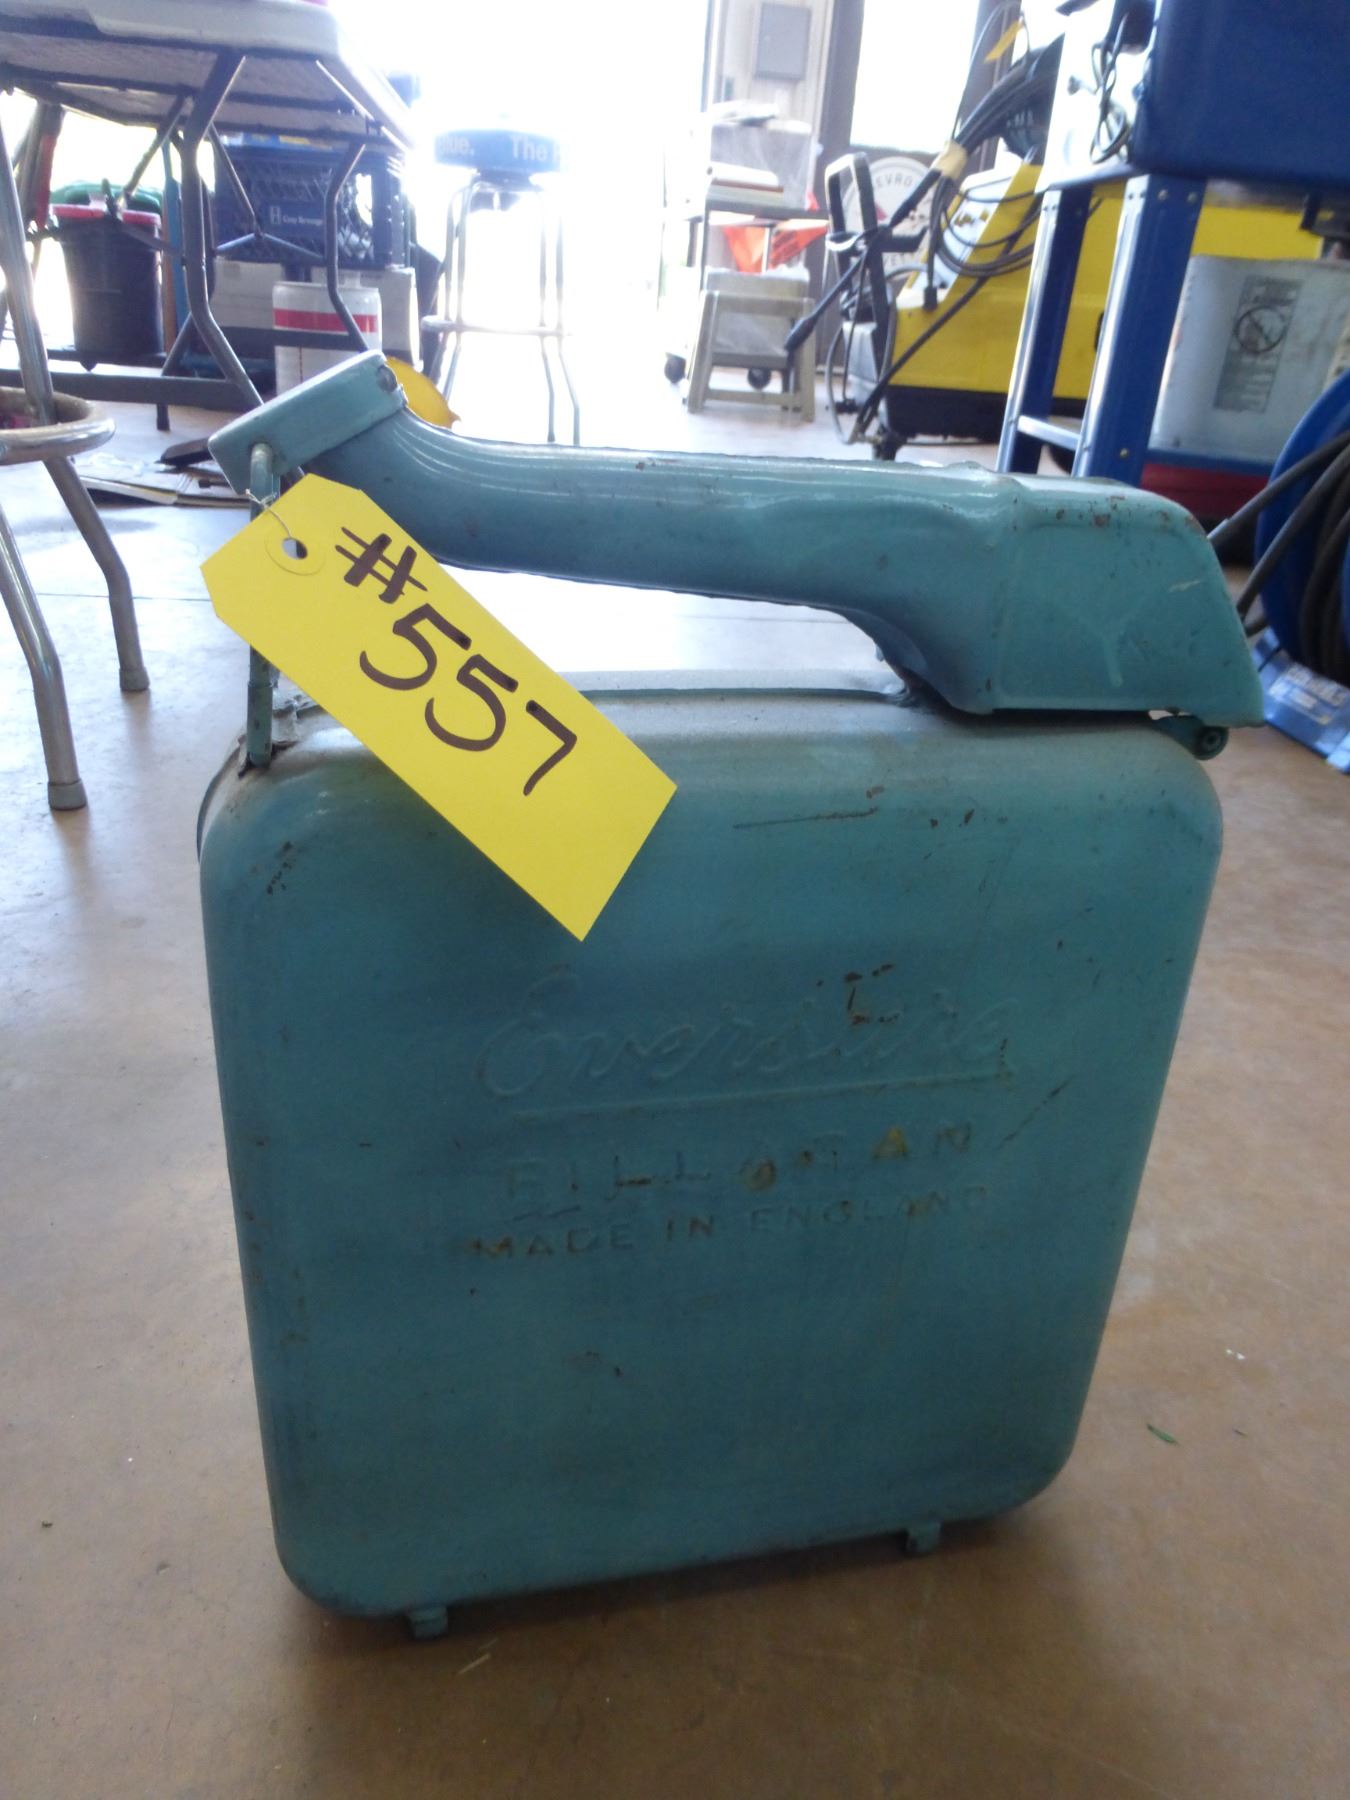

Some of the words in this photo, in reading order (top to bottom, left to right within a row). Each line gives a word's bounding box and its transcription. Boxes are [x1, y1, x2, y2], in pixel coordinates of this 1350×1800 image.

[335, 525, 578, 797] #557
[467, 1222, 634, 1259] MADE
[665, 1214, 715, 1241] IN
